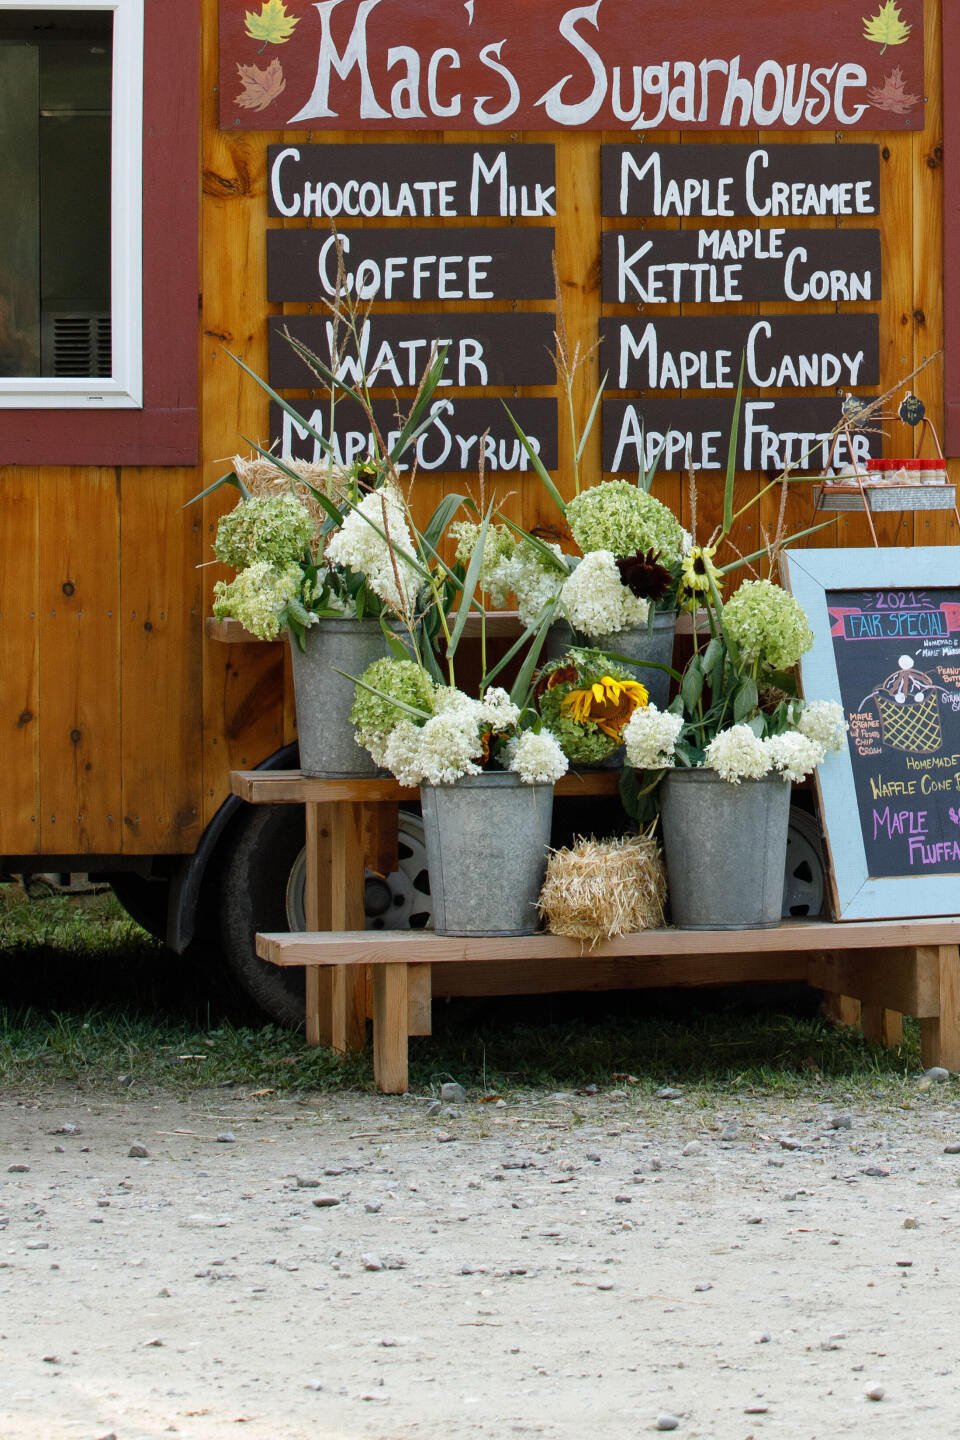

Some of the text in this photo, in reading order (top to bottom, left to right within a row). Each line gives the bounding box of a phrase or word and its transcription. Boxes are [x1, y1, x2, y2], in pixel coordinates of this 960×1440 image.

[270, 147, 556, 216] CHOCOLATE MILK
[620, 150, 875, 216] MAPLE CREAMEE
[319, 235, 493, 299] COFFEE
[618, 232, 871, 303] KETTLE CORN
[698, 228, 785, 258] MAPLE
[326, 320, 488, 387] WATER
[619, 321, 864, 389] MAPLE CANDY
[416, 399, 541, 471] SYRUP
[611, 405, 722, 472] APPLE
[850, 612, 948, 637] FAIR SPECIAL
[876, 592, 922, 608] 2021
[849, 713, 873, 721] MAPLE
[870, 774, 917, 800] WAFFLE
[921, 774, 952, 795] CONE
[906, 754, 960, 770] HOMEMADE
[873, 806, 928, 840] MAPLE
